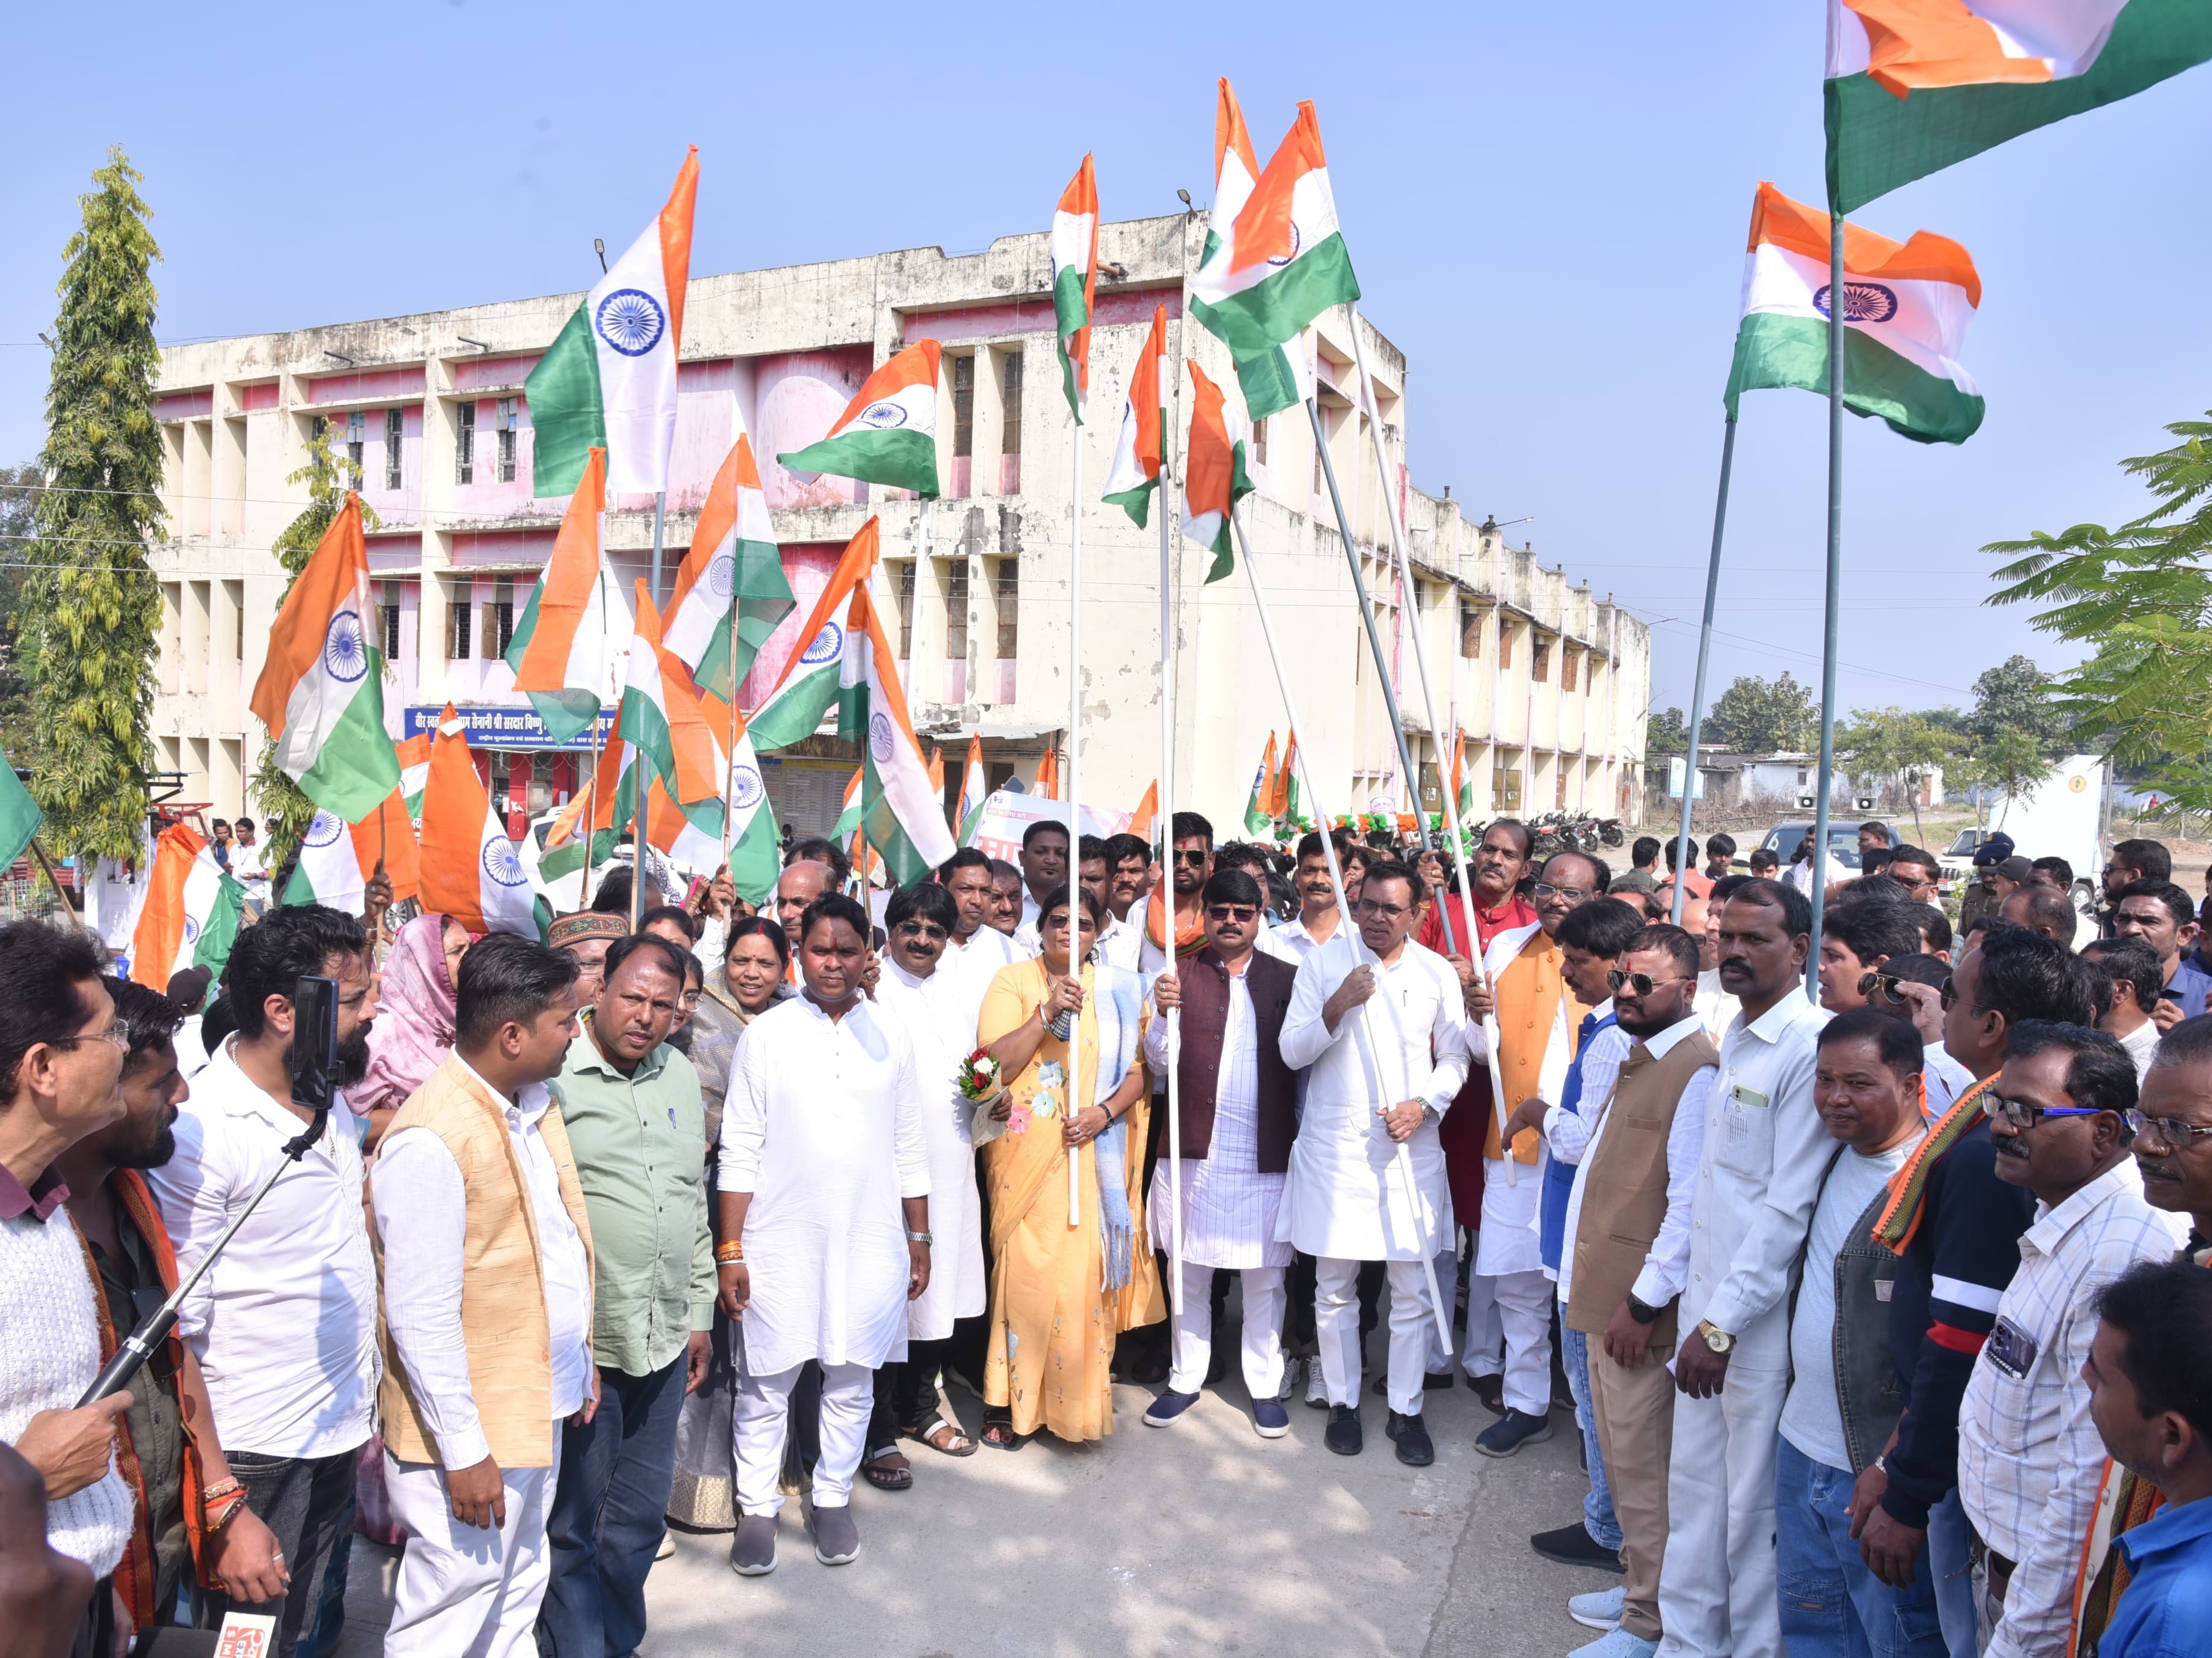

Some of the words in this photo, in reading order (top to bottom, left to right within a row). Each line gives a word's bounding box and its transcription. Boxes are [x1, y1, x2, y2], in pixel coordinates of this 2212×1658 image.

[415, 712, 426, 728] वीर
[494, 713, 502, 729] श्री
[504, 717, 524, 729] सरदार
[526, 713, 543, 735] विष्णु
